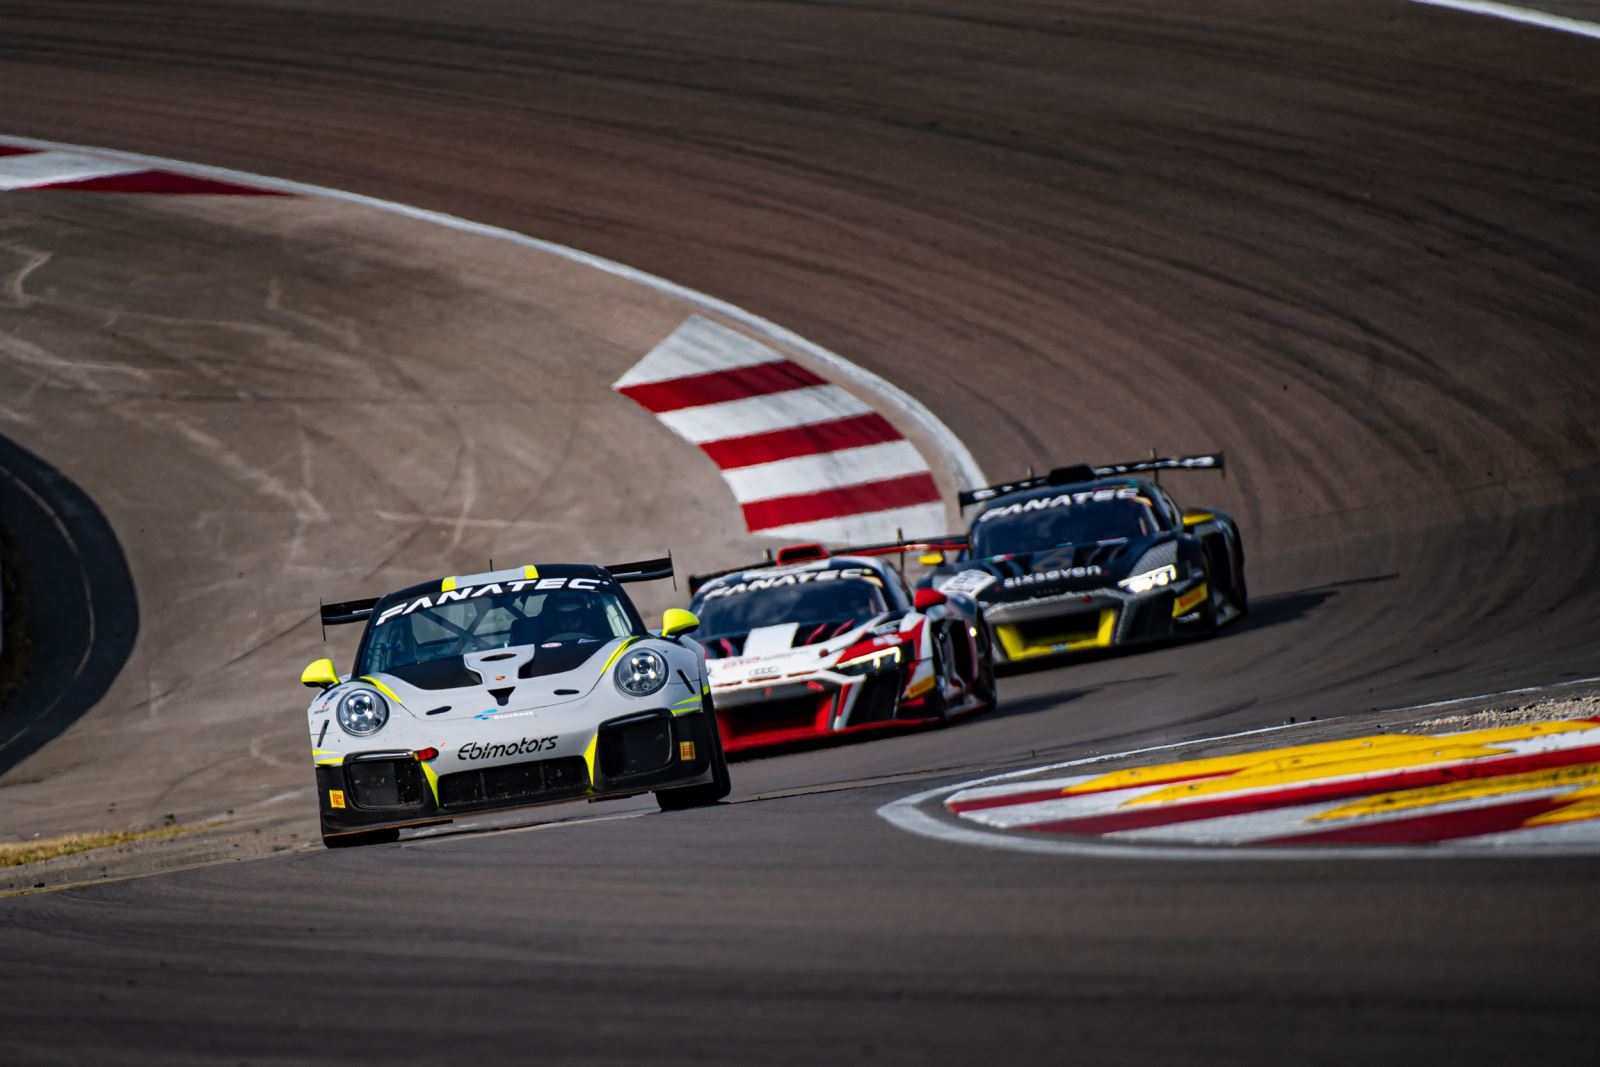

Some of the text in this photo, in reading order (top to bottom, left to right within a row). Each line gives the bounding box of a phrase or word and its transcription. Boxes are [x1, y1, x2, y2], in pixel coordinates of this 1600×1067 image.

[979, 488, 1139, 522] FANATEC
[703, 568, 864, 600] FANATEC
[375, 577, 602, 627] FANATEC
[457, 735, 559, 761] Ebimotors
